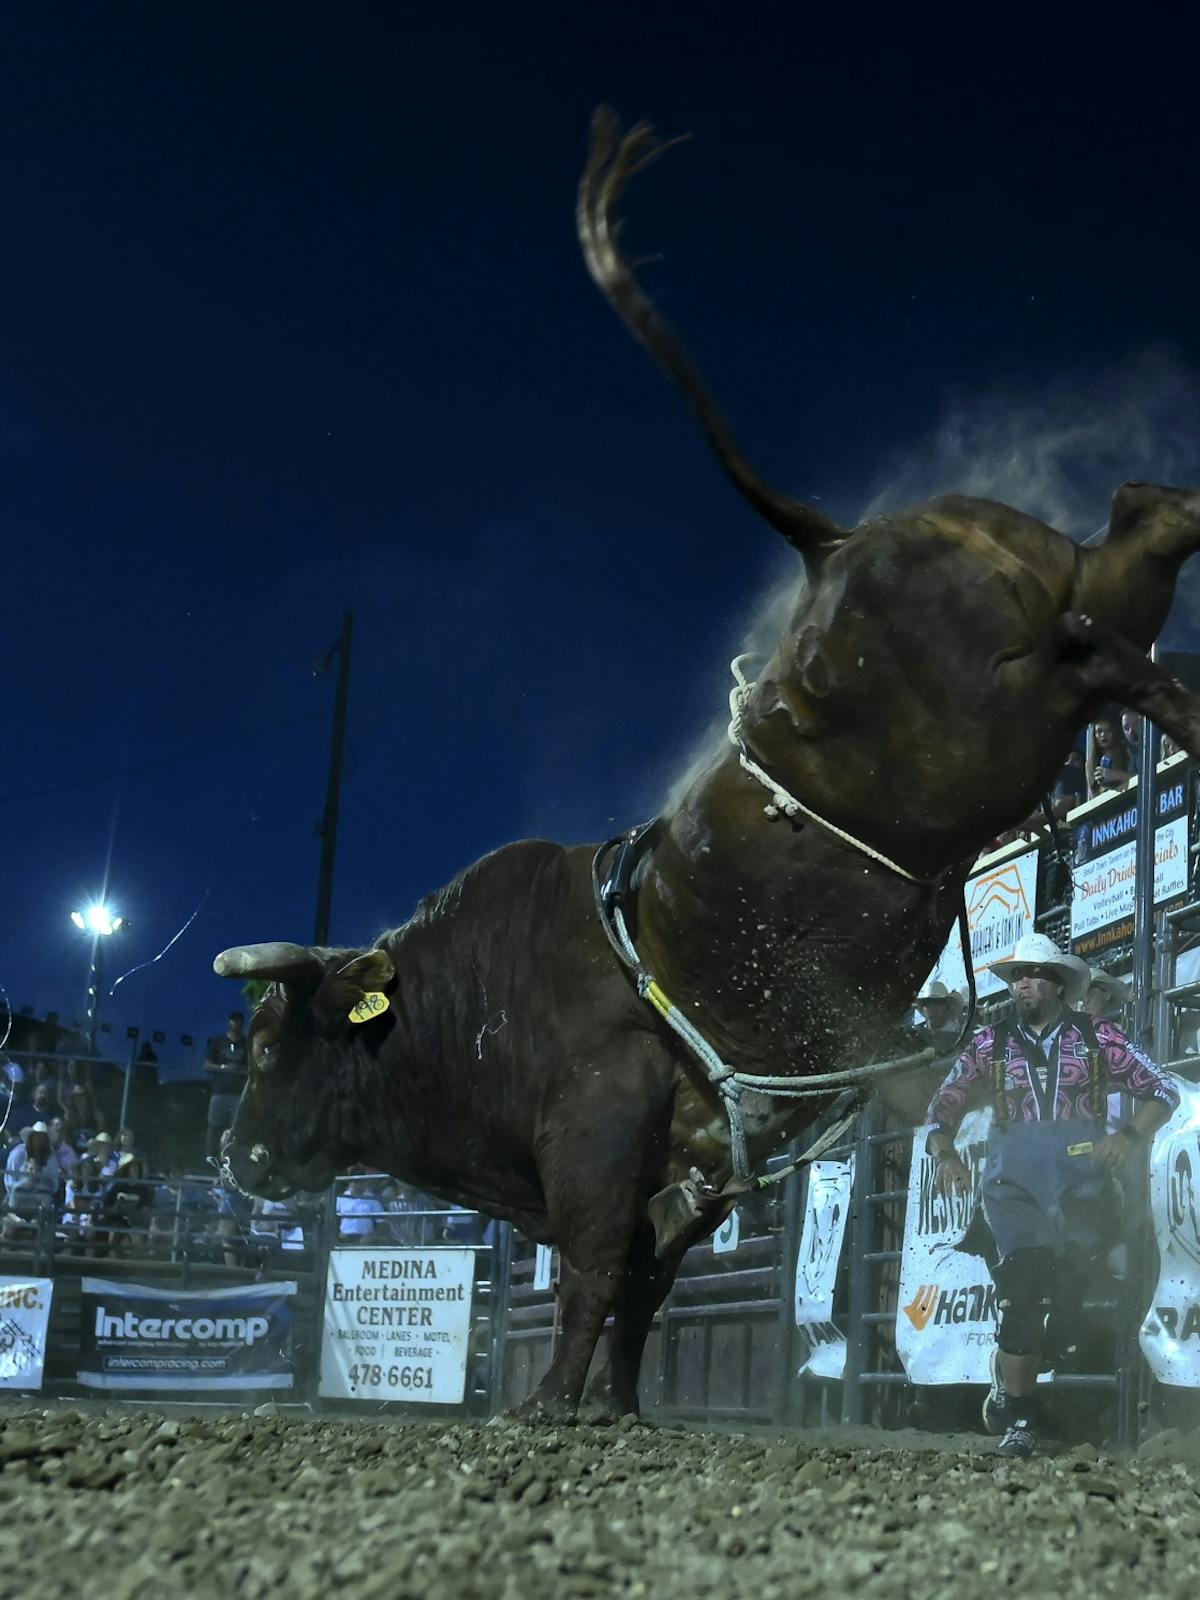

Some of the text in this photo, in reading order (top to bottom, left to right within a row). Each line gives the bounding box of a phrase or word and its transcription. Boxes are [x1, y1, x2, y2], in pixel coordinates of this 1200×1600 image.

[1160, 784, 1183, 814] BAR
[1081, 874, 1107, 901] Daily
[1161, 880, 1184, 895] Raffles
[362, 1260, 437, 1279] MEDINA
[333, 1282, 465, 1302] Entertainment
[95, 1306, 269, 1346] Intercomp
[357, 1306, 433, 1327] CENTER
[386, 1331, 411, 1341] LANES
[424, 1332, 450, 1343] MOTEL
[394, 1347, 432, 1358] BEVERAGE
[107, 1357, 226, 1371] intercompracing.com
